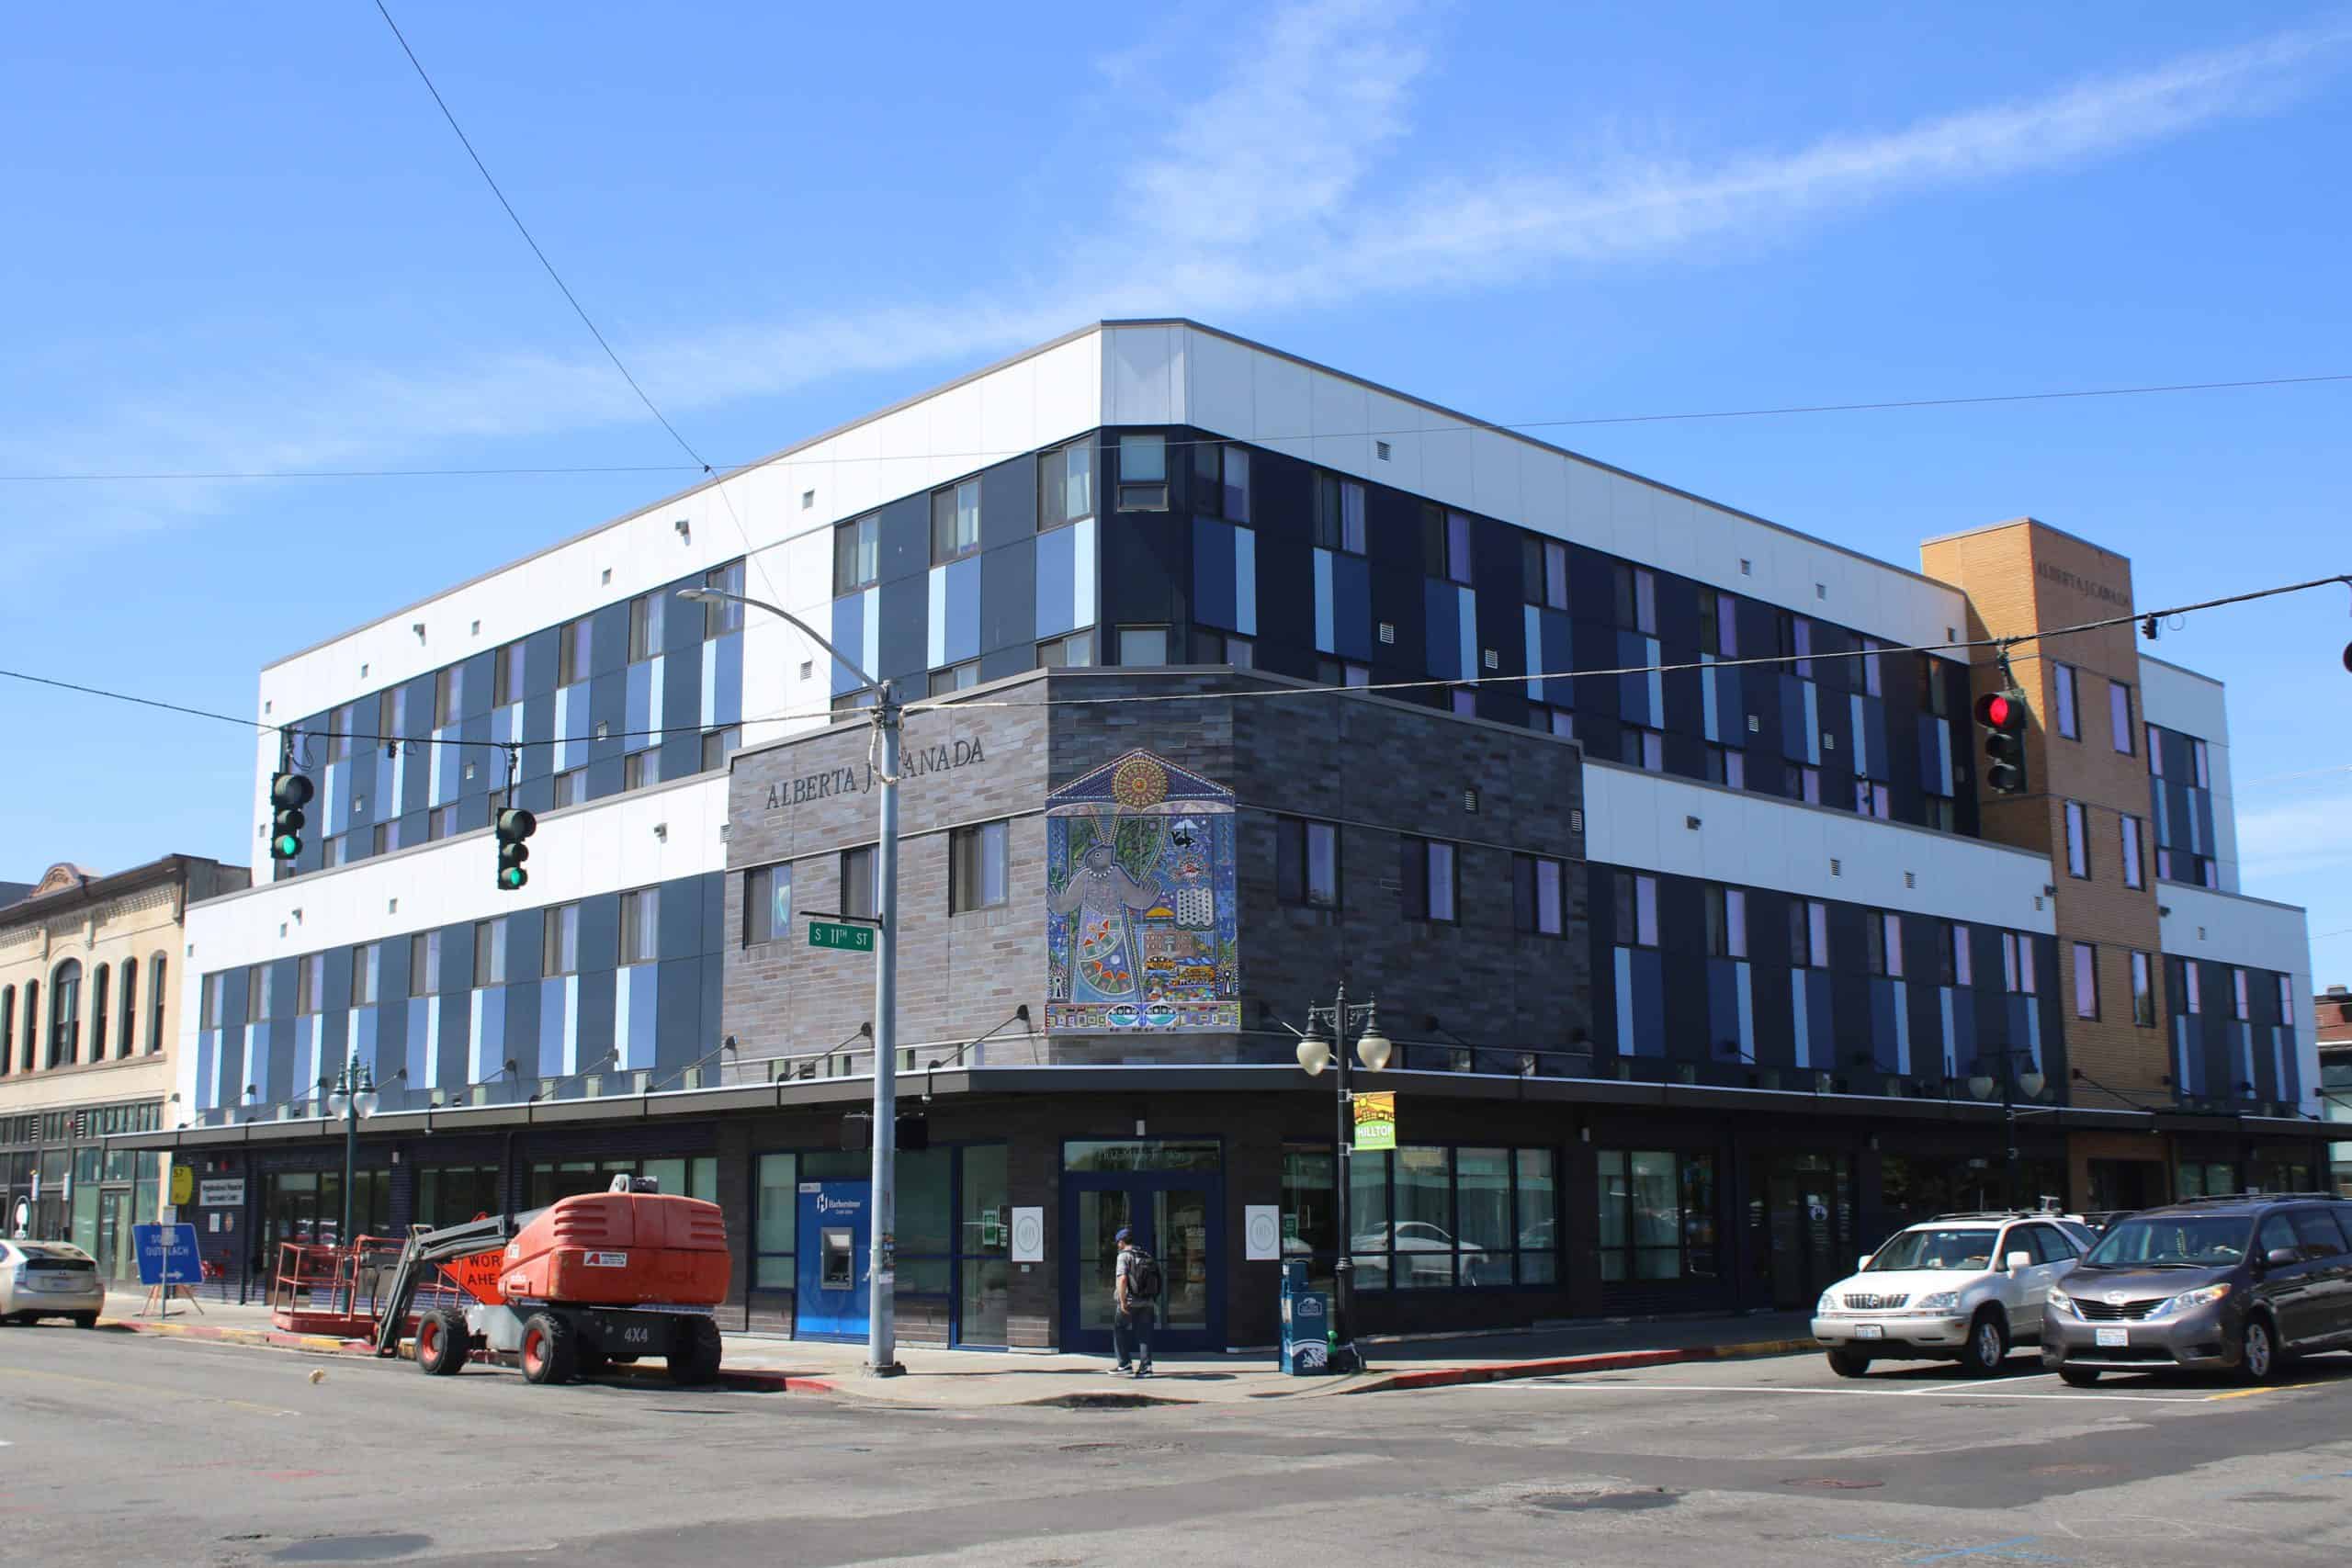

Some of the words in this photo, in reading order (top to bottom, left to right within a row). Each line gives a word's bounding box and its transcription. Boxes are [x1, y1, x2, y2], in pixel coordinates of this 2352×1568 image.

[765, 766, 857, 809] ALBERTA
[899, 736, 986, 779] ANADA
[815, 927, 821, 942] S
[856, 932, 867, 946] ST
[146, 1246, 189, 1257] OUTEACH
[469, 1255, 501, 1267] WOR
[468, 1273, 497, 1285] AHE
